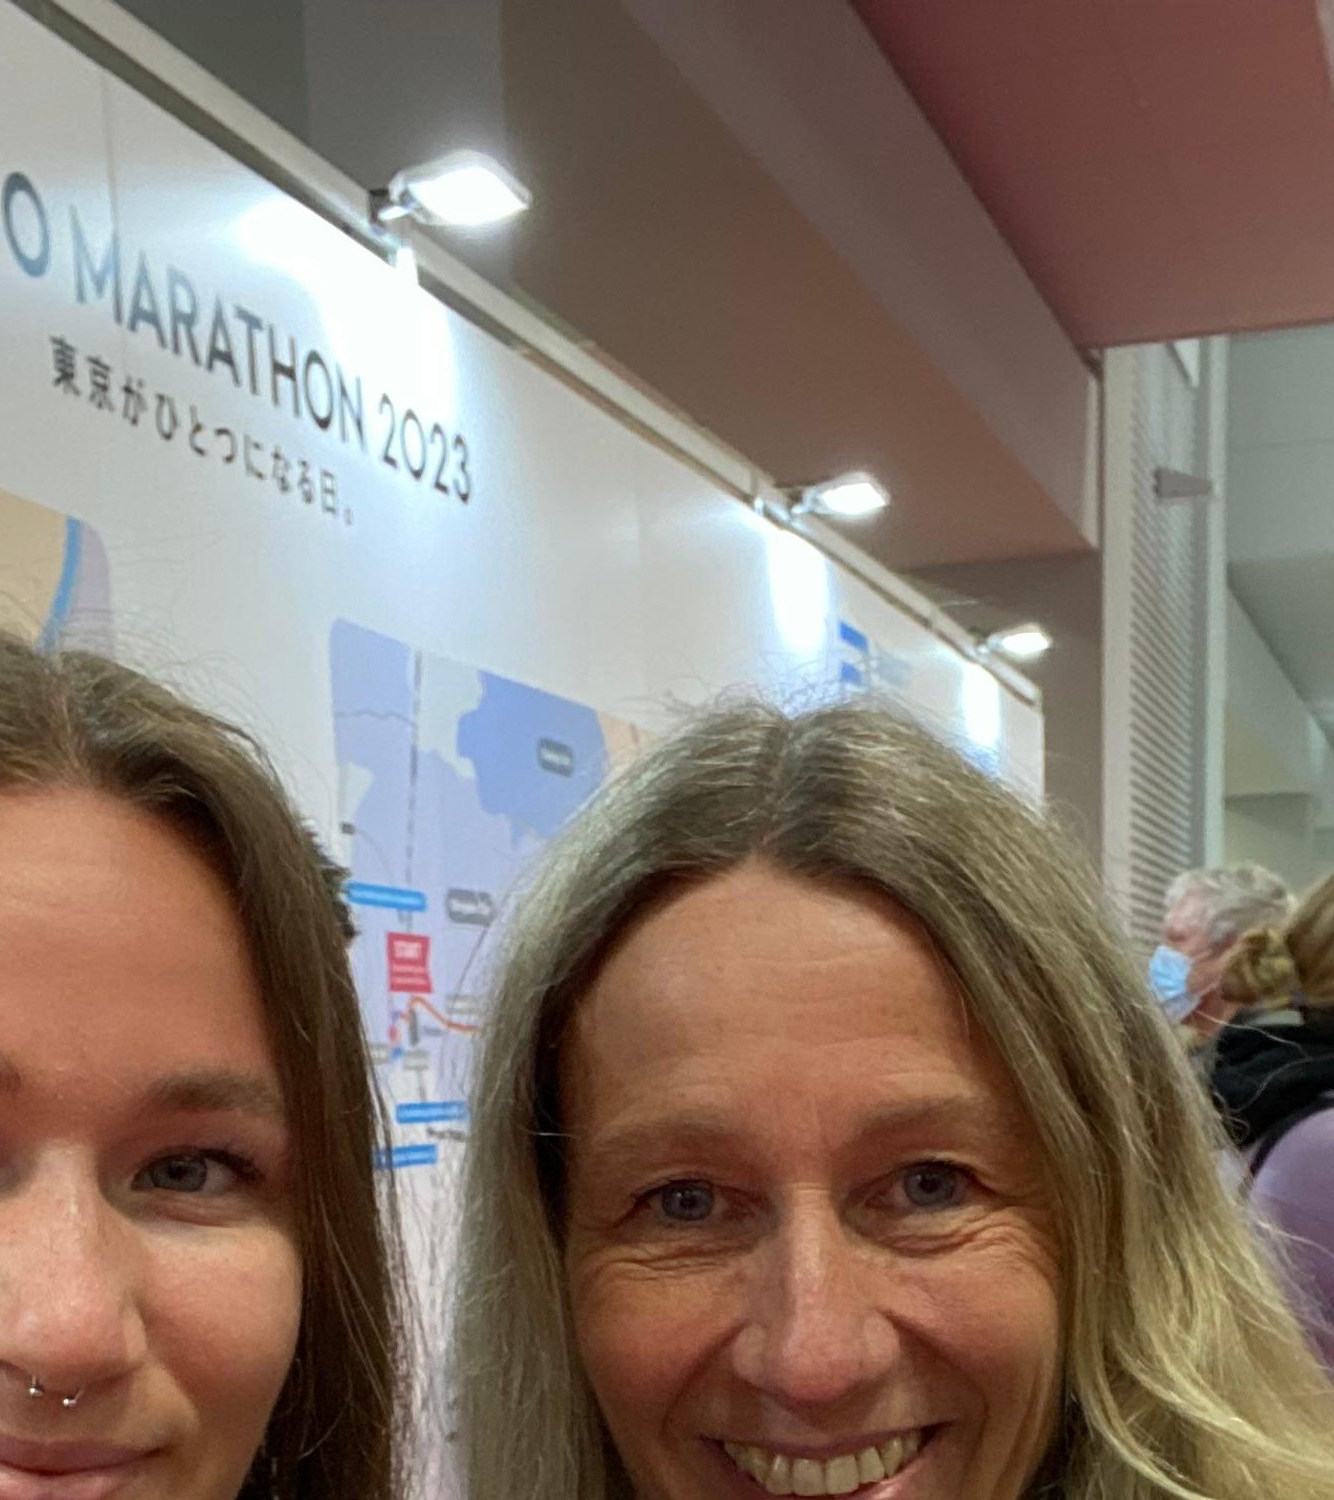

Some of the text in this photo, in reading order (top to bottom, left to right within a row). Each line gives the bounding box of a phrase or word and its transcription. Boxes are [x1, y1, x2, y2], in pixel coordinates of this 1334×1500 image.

[50, 336, 353, 525] 東京がひとつになる日。
[69, 204, 366, 452] MARATHON
[379, 393, 471, 504] 2023
